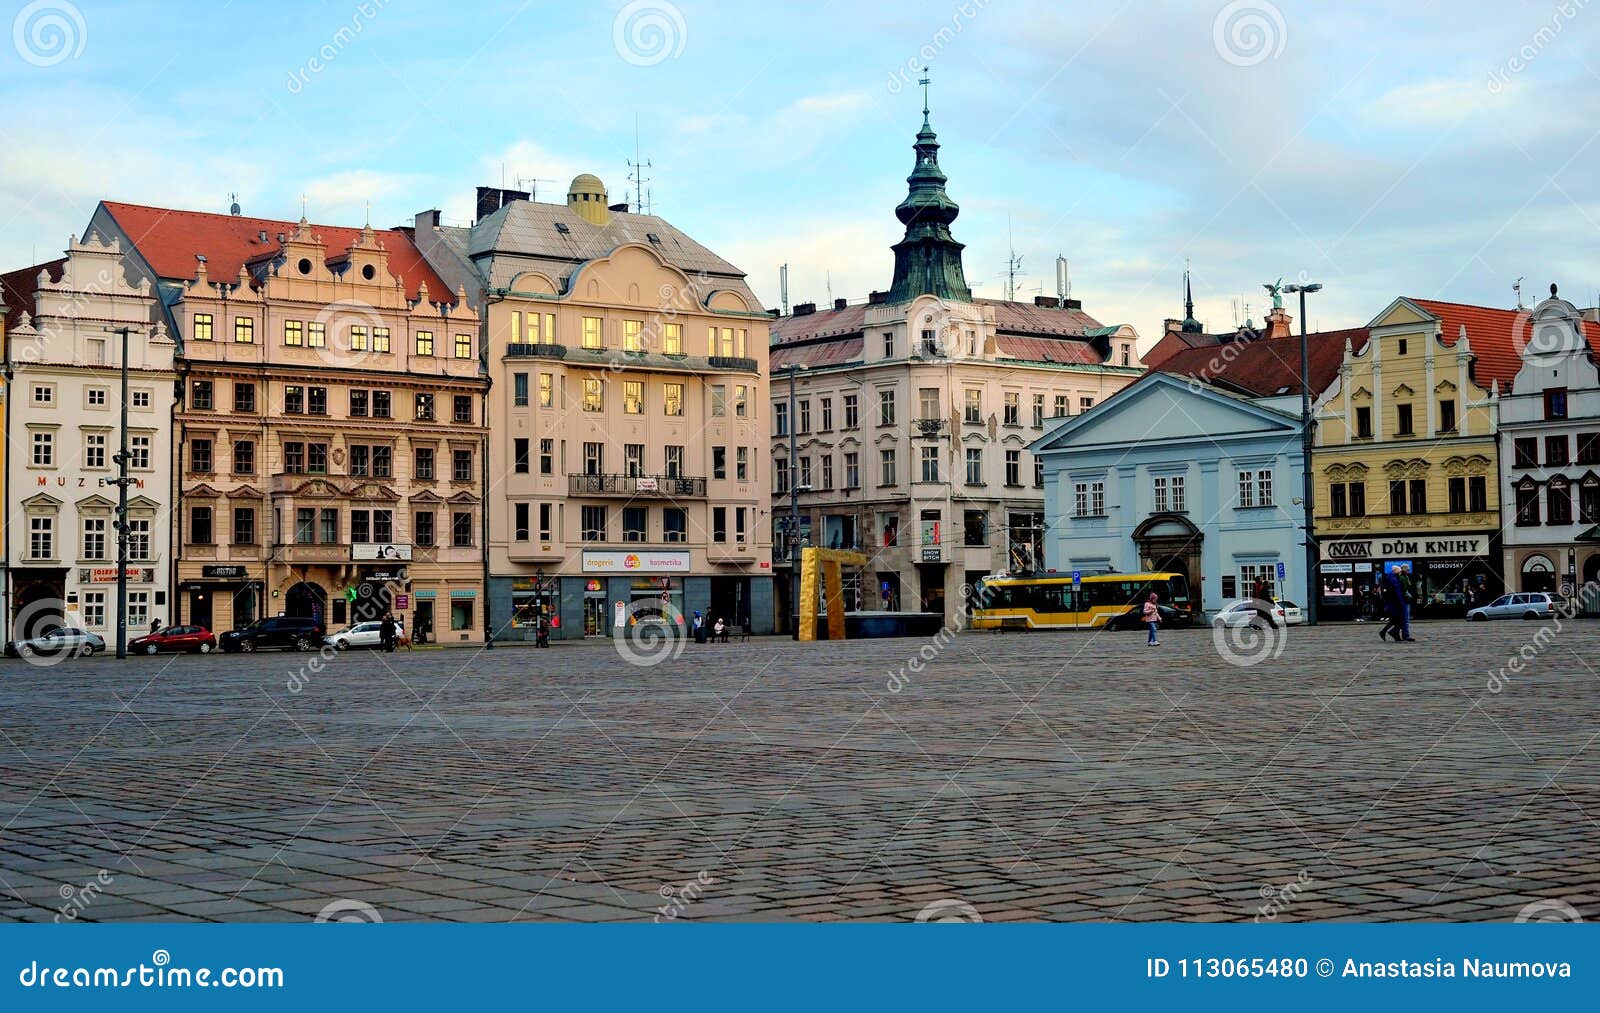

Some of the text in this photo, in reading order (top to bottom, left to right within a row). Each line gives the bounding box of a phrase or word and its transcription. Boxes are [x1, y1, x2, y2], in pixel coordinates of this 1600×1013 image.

[37, 476, 144, 489] MUZEM
[1332, 539, 1479, 556] NAVA DŮM KNIHY
[587, 559, 614, 567] drogerie
